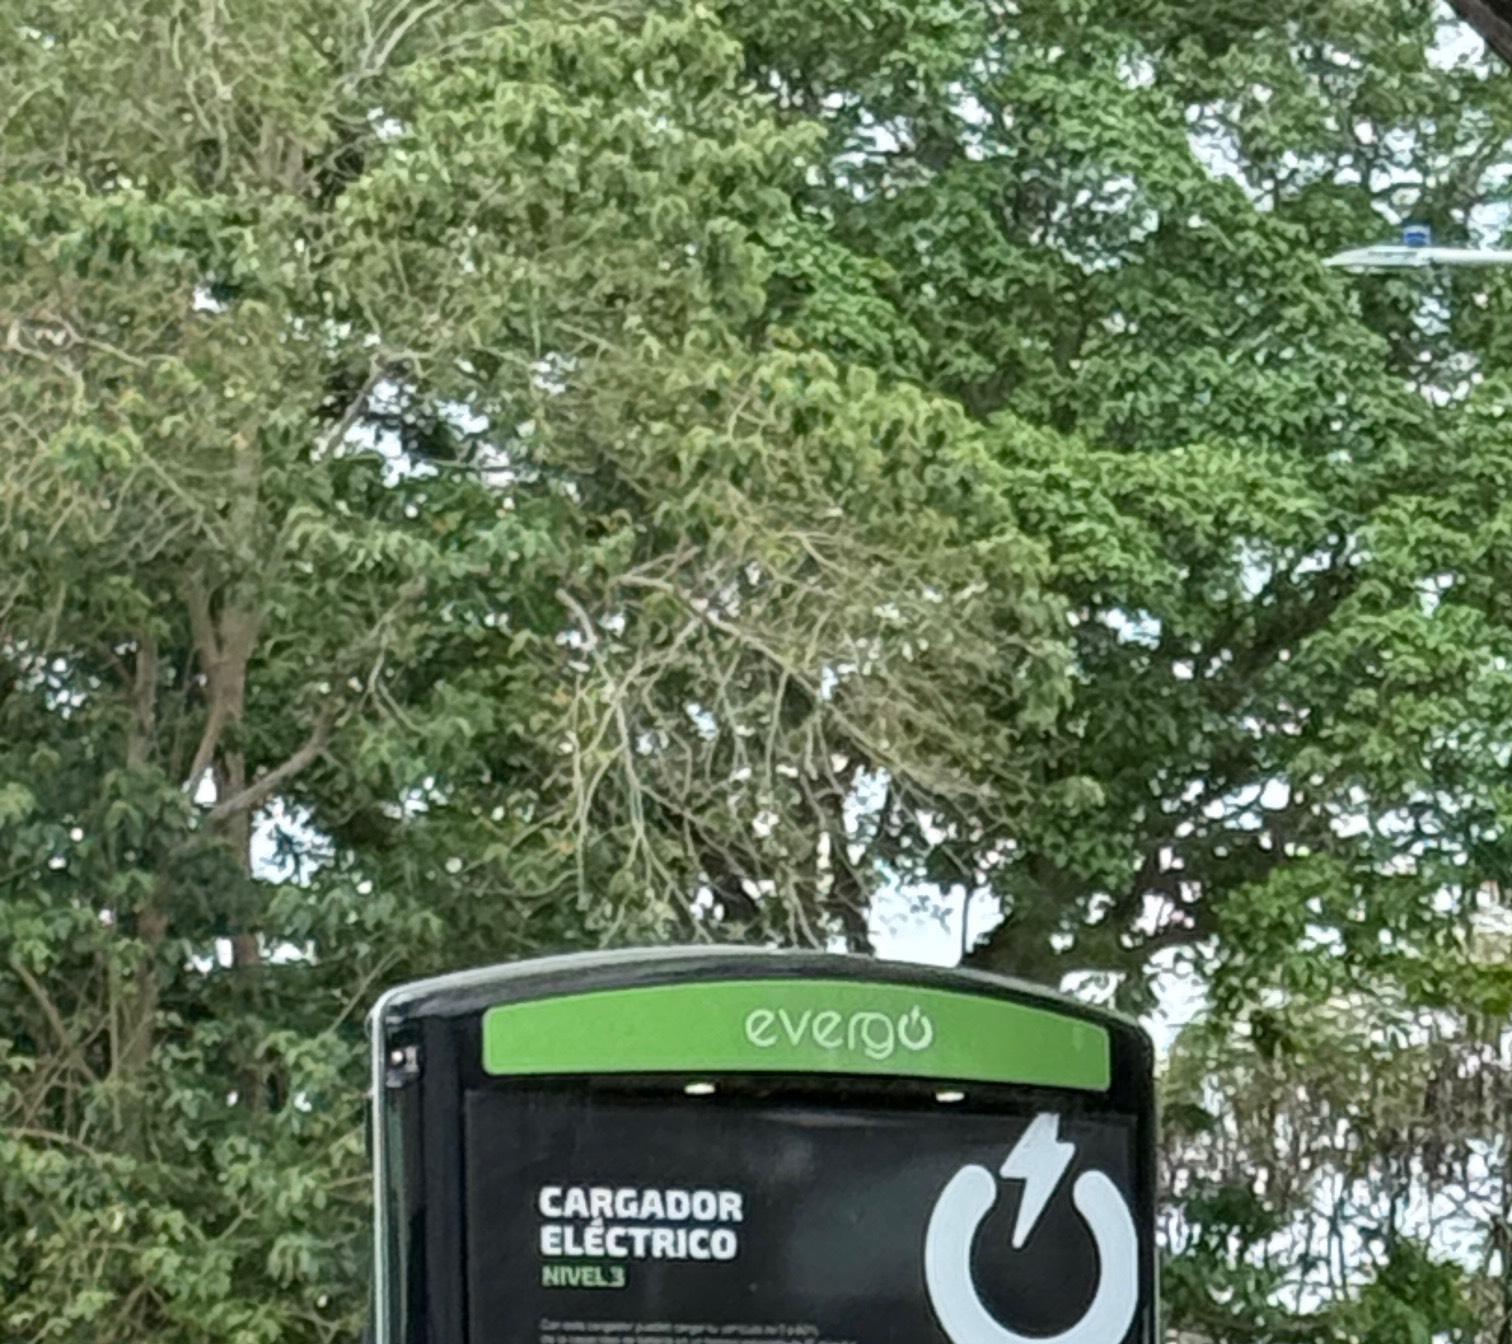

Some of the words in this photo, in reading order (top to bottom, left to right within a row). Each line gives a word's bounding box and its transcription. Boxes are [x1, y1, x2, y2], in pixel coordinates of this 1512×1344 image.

[745, 1004, 933, 1060] evergo
[538, 1186, 743, 1222] CARGADOR
[540, 1216, 738, 1260] ELÉCTRICO
[541, 1265, 609, 1287] NIVEL
